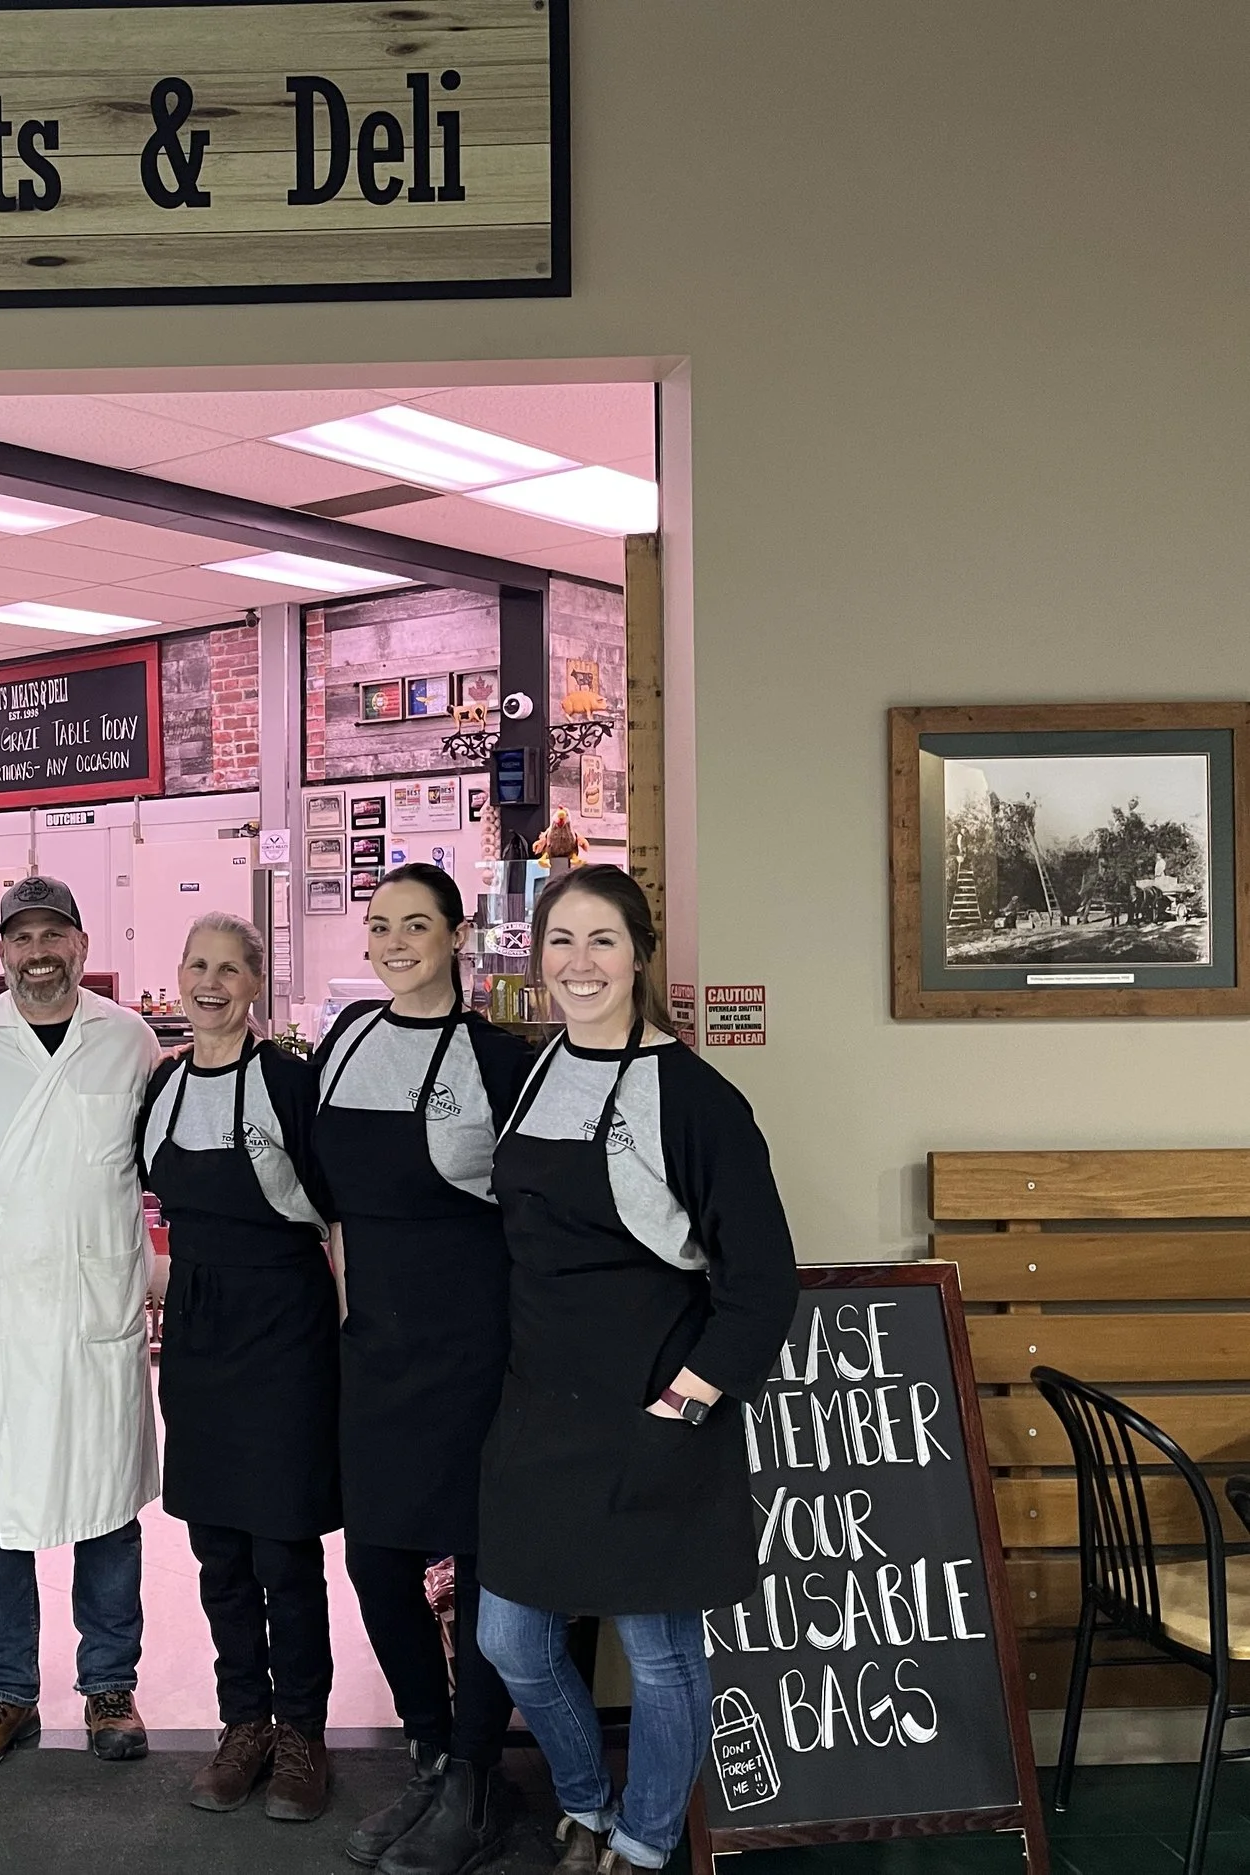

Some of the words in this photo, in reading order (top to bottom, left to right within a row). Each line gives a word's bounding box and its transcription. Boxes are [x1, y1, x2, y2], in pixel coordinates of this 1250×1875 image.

[141, 77, 212, 209] &
[287, 69, 466, 206] Deli
[11, 681, 40, 710] MEATS
[48, 677, 69, 705] DELI
[8, 711, 23, 721] EST.
[0, 726, 41, 753] GRAZE
[51, 718, 91, 747] TABLE
[100, 713, 139, 741] TODAY
[46, 756, 69, 778] ANY
[76, 749, 130, 773] OCCASION
[46, 811, 87, 826] BUTCHER
[707, 988, 763, 1002] CAUTION
[708, 1005, 737, 1013] OVERHEAD
[707, 1033, 731, 1045] KEEP
[734, 1033, 764, 1044] CLEAR
[436, 1101, 462, 1115] MEATS
[611, 1131, 637, 1150] MEAT
[767, 1302, 904, 1385] EASE
[744, 1382, 952, 1474] MEMBER
[751, 1486, 888, 1566] YOUR
[779, 1657, 939, 1755] BAGS
[722, 1740, 751, 1759] DONT
[721, 1754, 763, 1779] FORGET
[732, 1780, 750, 1797] ME
